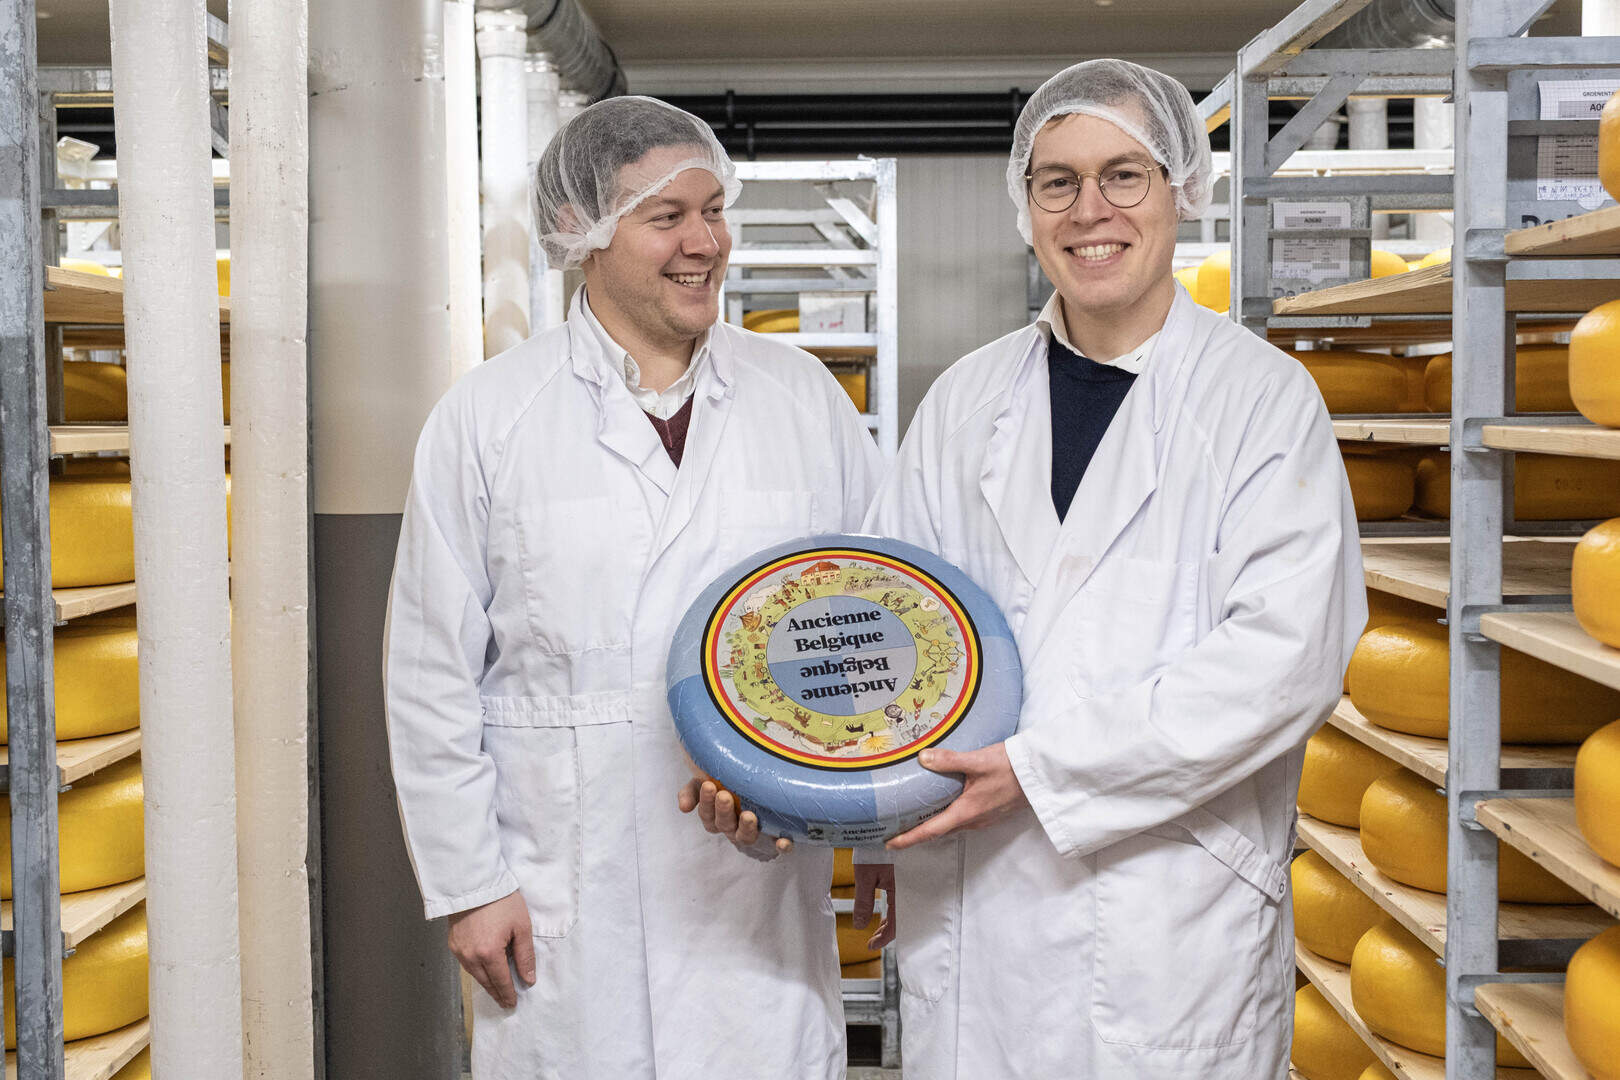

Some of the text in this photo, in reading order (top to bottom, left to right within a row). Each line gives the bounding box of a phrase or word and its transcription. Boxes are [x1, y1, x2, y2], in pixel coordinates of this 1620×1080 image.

[786, 610, 882, 632] Ancienne
[793, 631, 885, 652] Belgique
[800, 656, 890, 678] Belgique
[800, 677, 898, 700] Ancienne
